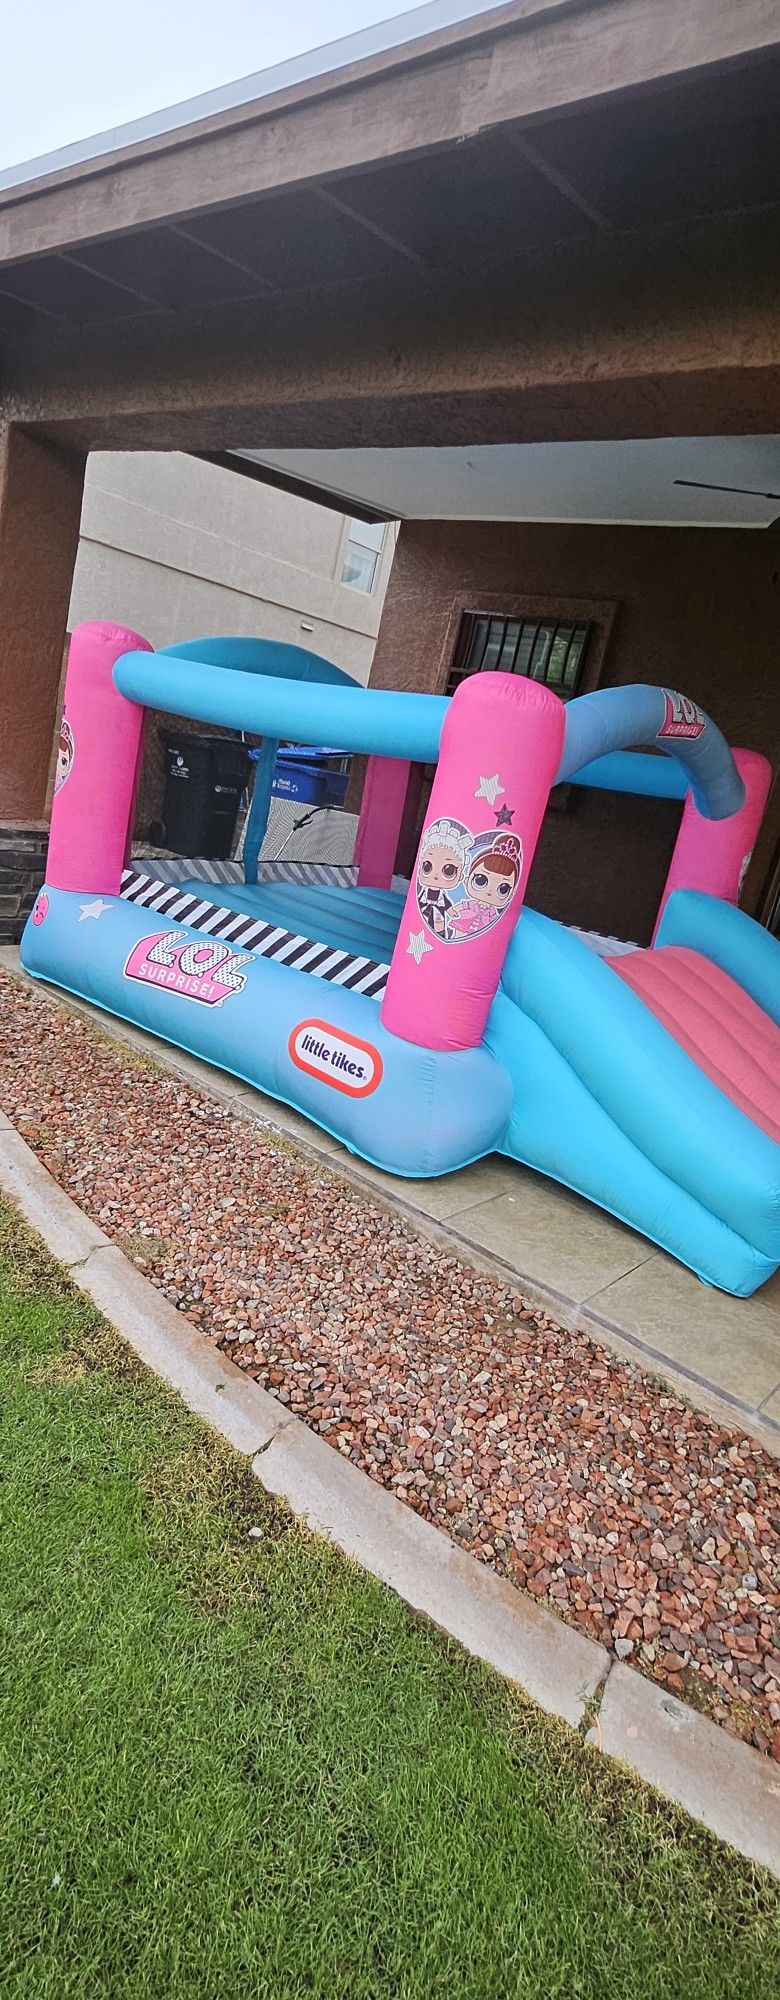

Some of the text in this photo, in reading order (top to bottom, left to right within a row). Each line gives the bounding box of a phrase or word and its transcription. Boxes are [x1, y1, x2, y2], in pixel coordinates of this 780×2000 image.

[138, 963, 216, 998] SURPRISE!
[301, 1034, 365, 1079] little tikes
